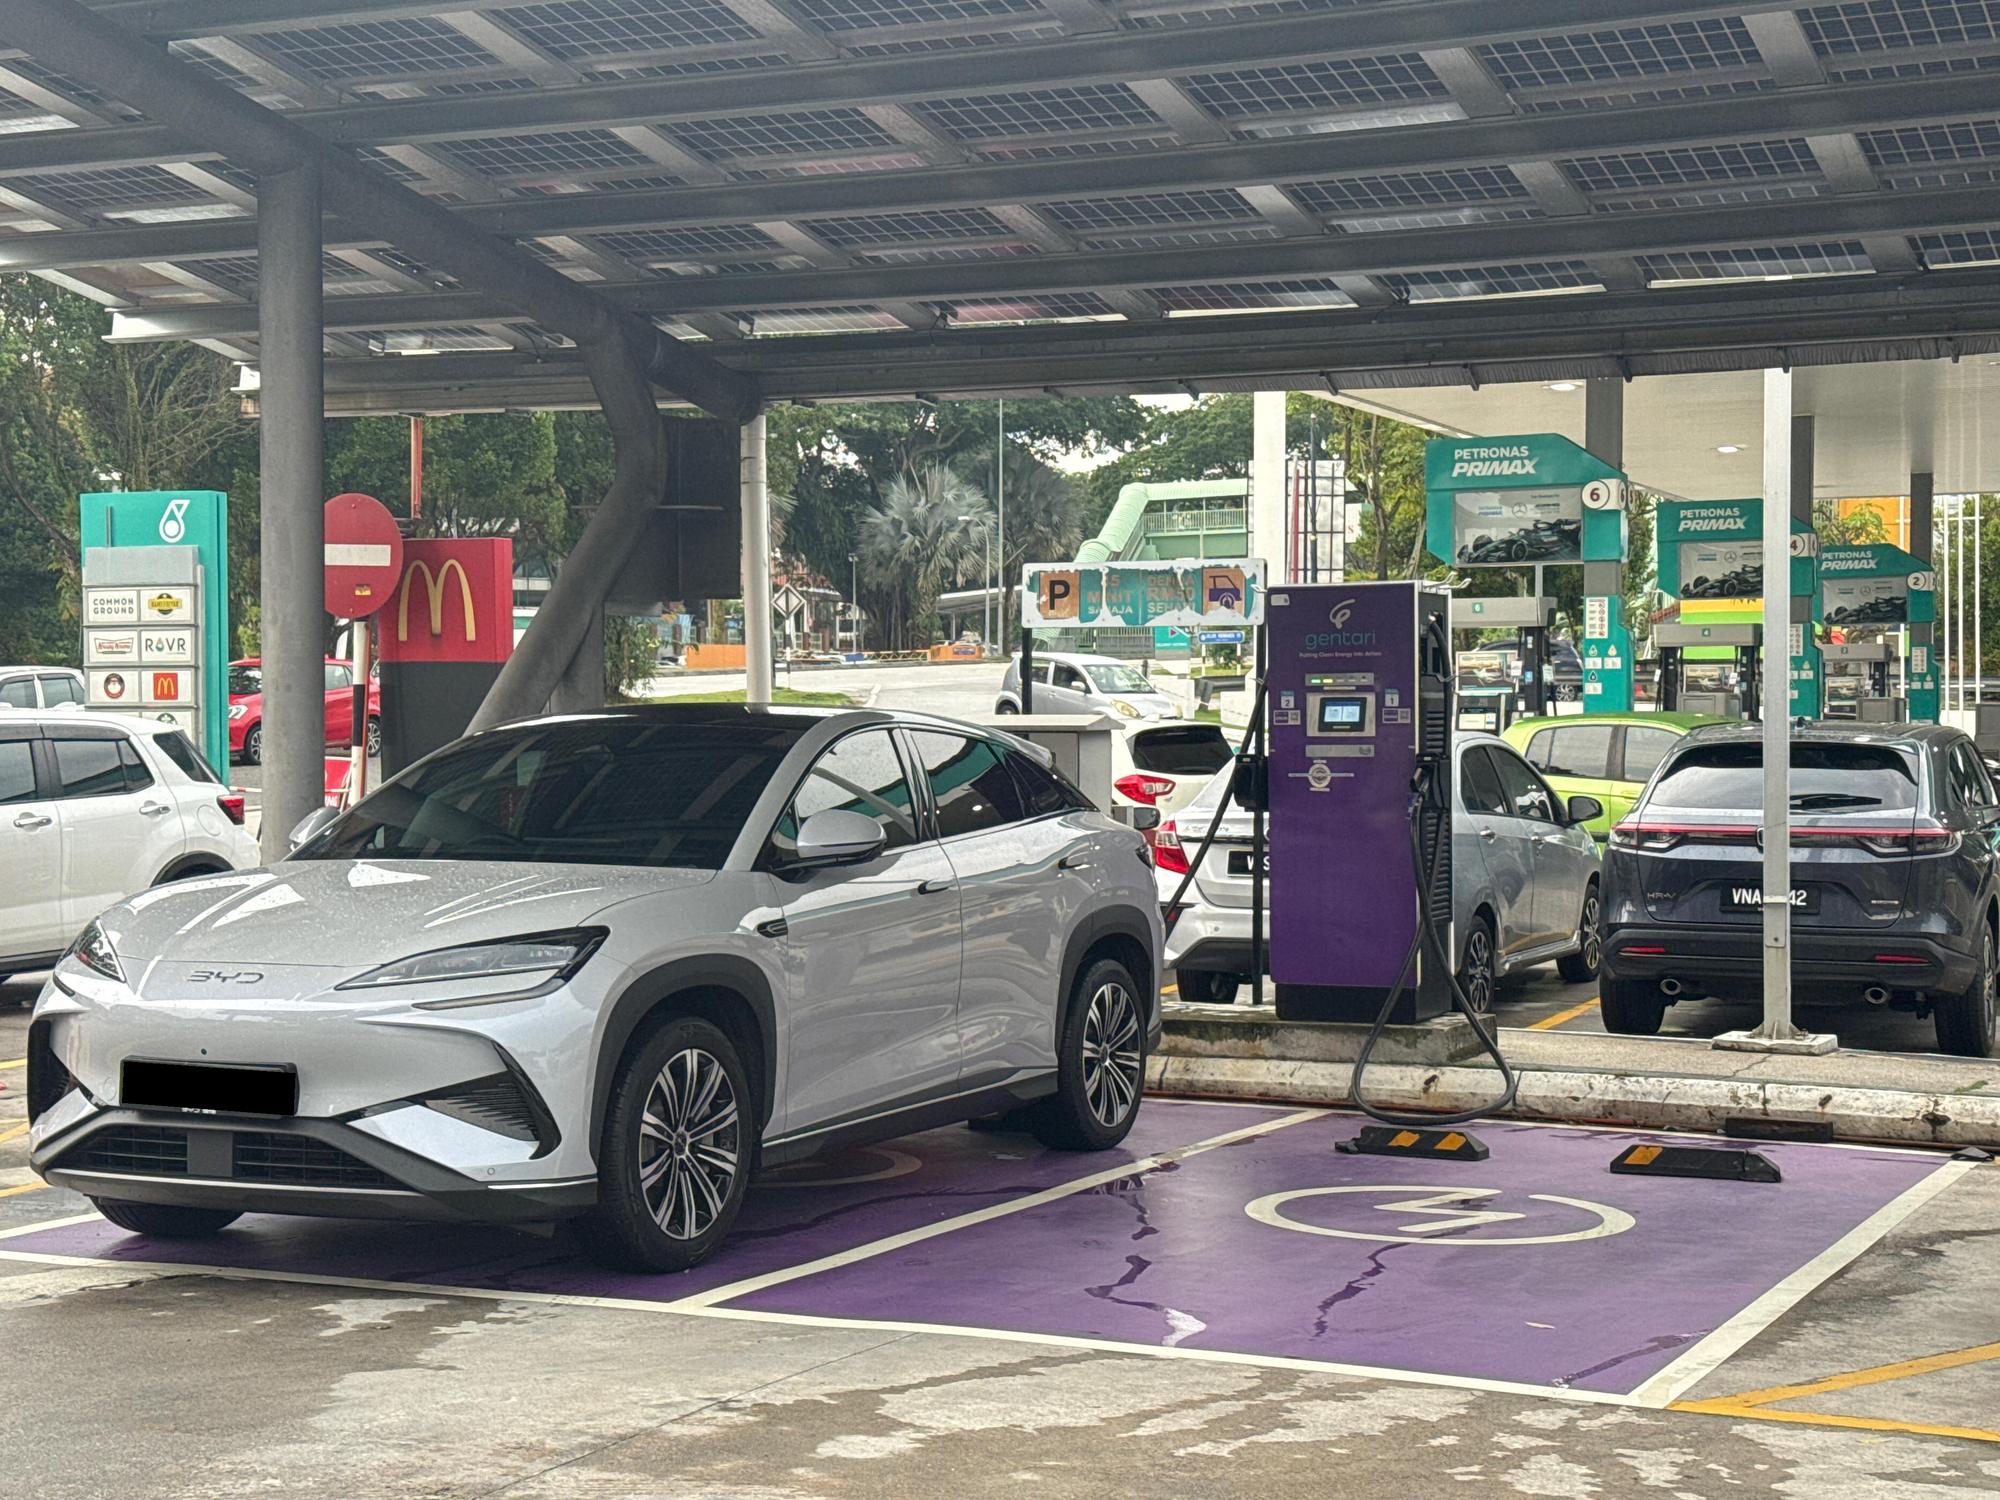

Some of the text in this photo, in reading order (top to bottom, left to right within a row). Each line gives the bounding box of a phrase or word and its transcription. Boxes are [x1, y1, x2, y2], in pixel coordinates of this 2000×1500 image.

[1454, 446, 1529, 460] PETRONAS
[1451, 458, 1540, 477] PRIMAX
[1589, 488, 1600, 502] 6
[1680, 507, 1740, 518] PETRONAS
[1678, 516, 1749, 532] PRIMAX
[1790, 540, 1798, 550] 4
[1821, 551, 1872, 560] PETRONAS
[1820, 559, 1879, 571] PRIMAX
[1913, 577, 1920, 586] 2
[1049, 580, 1070, 610] P
[1087, 591, 1133, 604] MNIT
[93, 598, 134, 606] COMMON
[93, 607, 134, 615] GROUND
[1305, 629, 1376, 650] gentari
[1647, 892, 1677, 900] HR-V
[1732, 888, 1762, 904] VNA
[187, 970, 264, 984] BYD
